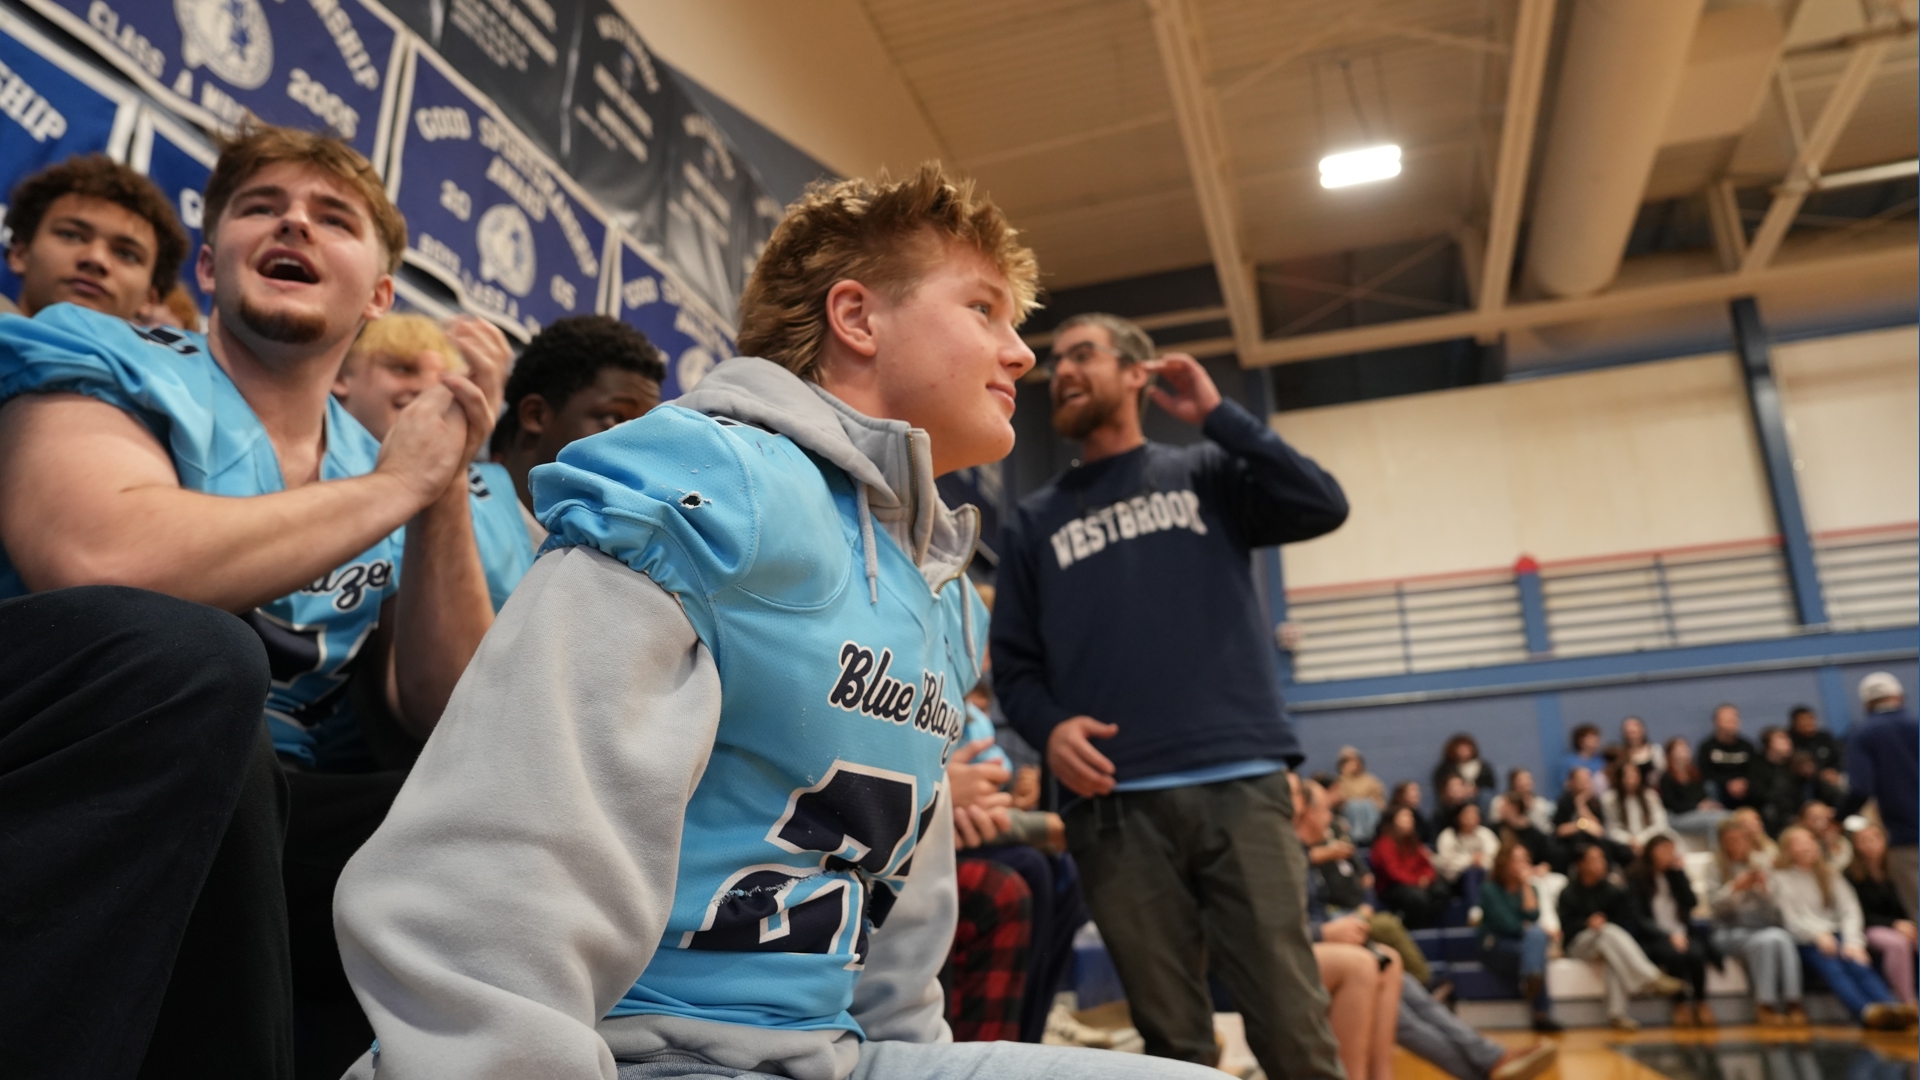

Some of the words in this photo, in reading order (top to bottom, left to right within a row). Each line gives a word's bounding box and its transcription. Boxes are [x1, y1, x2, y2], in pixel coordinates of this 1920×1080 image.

[87, 0, 166, 79] CLASS
[287, 67, 360, 140] 2005
[414, 105, 473, 142] GOOD
[439, 178, 473, 222] 20
[827, 639, 916, 726] Blue
